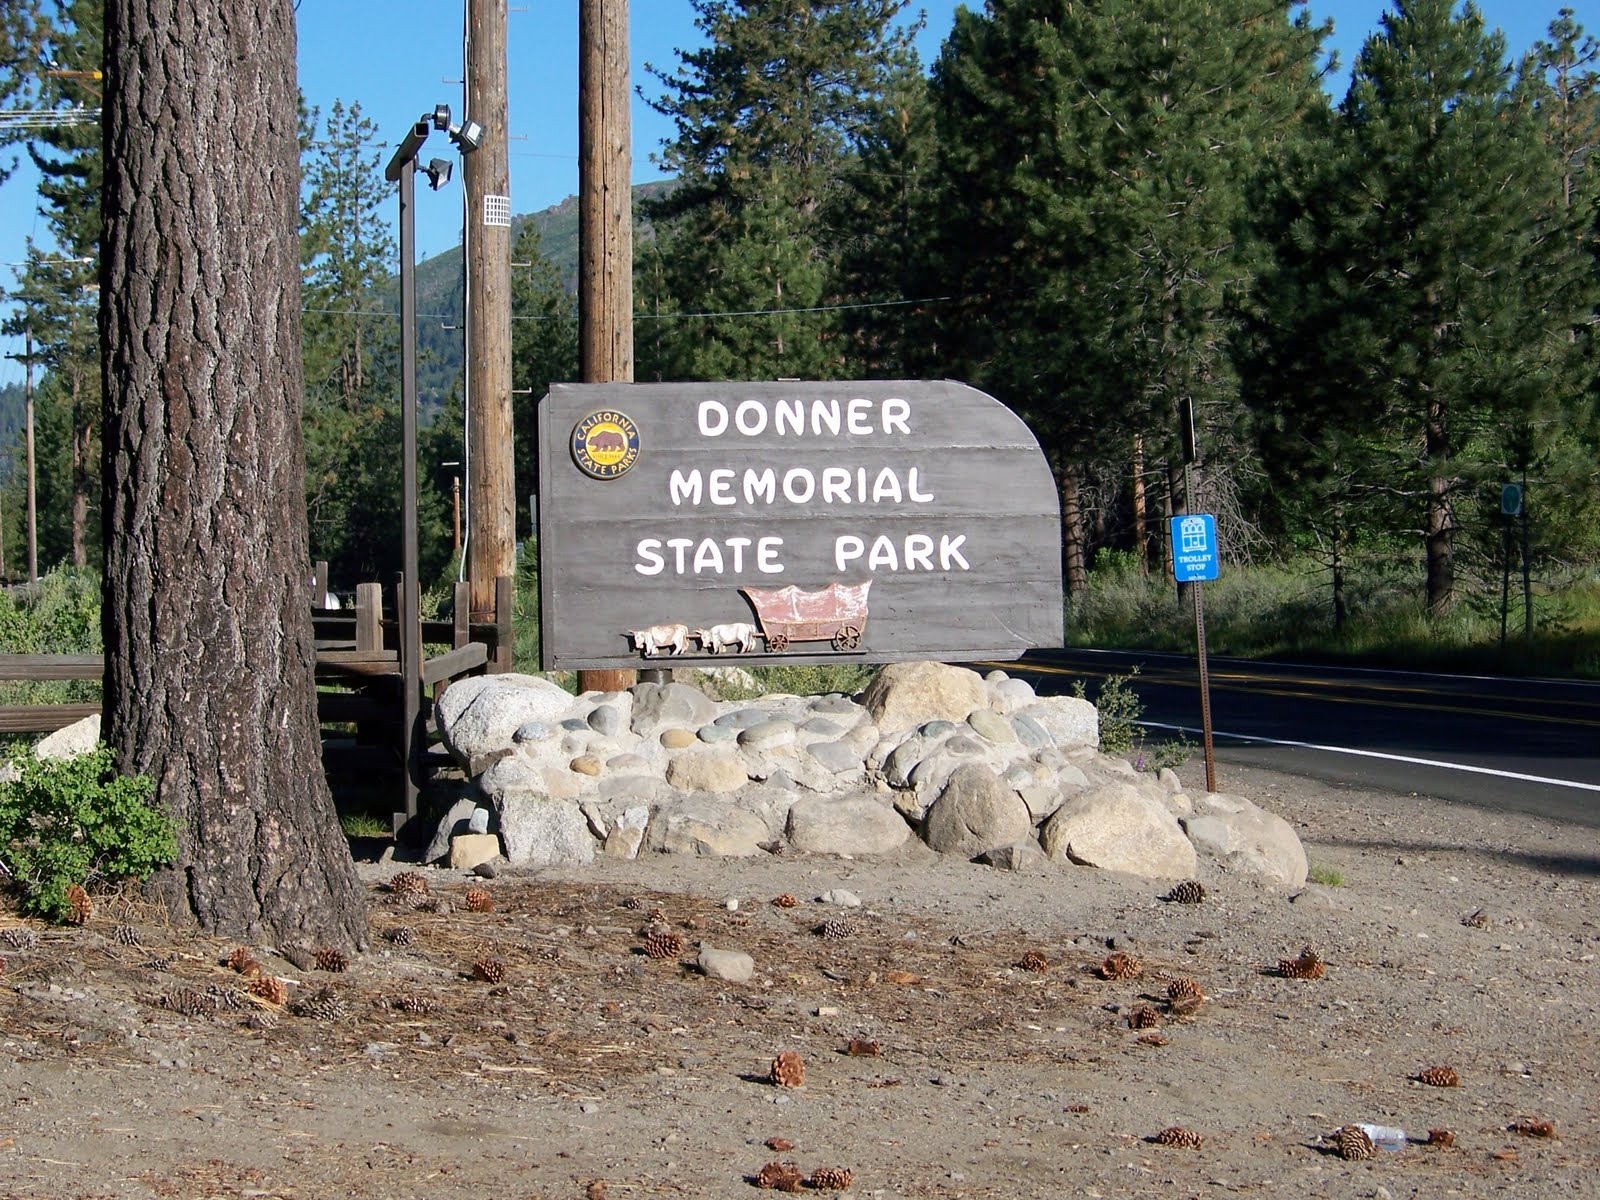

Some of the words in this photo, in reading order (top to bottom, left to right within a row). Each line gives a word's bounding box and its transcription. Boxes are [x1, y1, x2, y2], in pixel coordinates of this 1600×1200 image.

[577, 412, 636, 440] CALIFORNIA
[697, 398, 911, 437] DONNER
[577, 448, 607, 475] STATE
[611, 447, 637, 474] PARKS
[669, 466, 935, 506] MEMORIAL
[634, 536, 785, 576] STATE
[835, 533, 970, 572] PARK
[1178, 554, 1212, 563] TROLLEY
